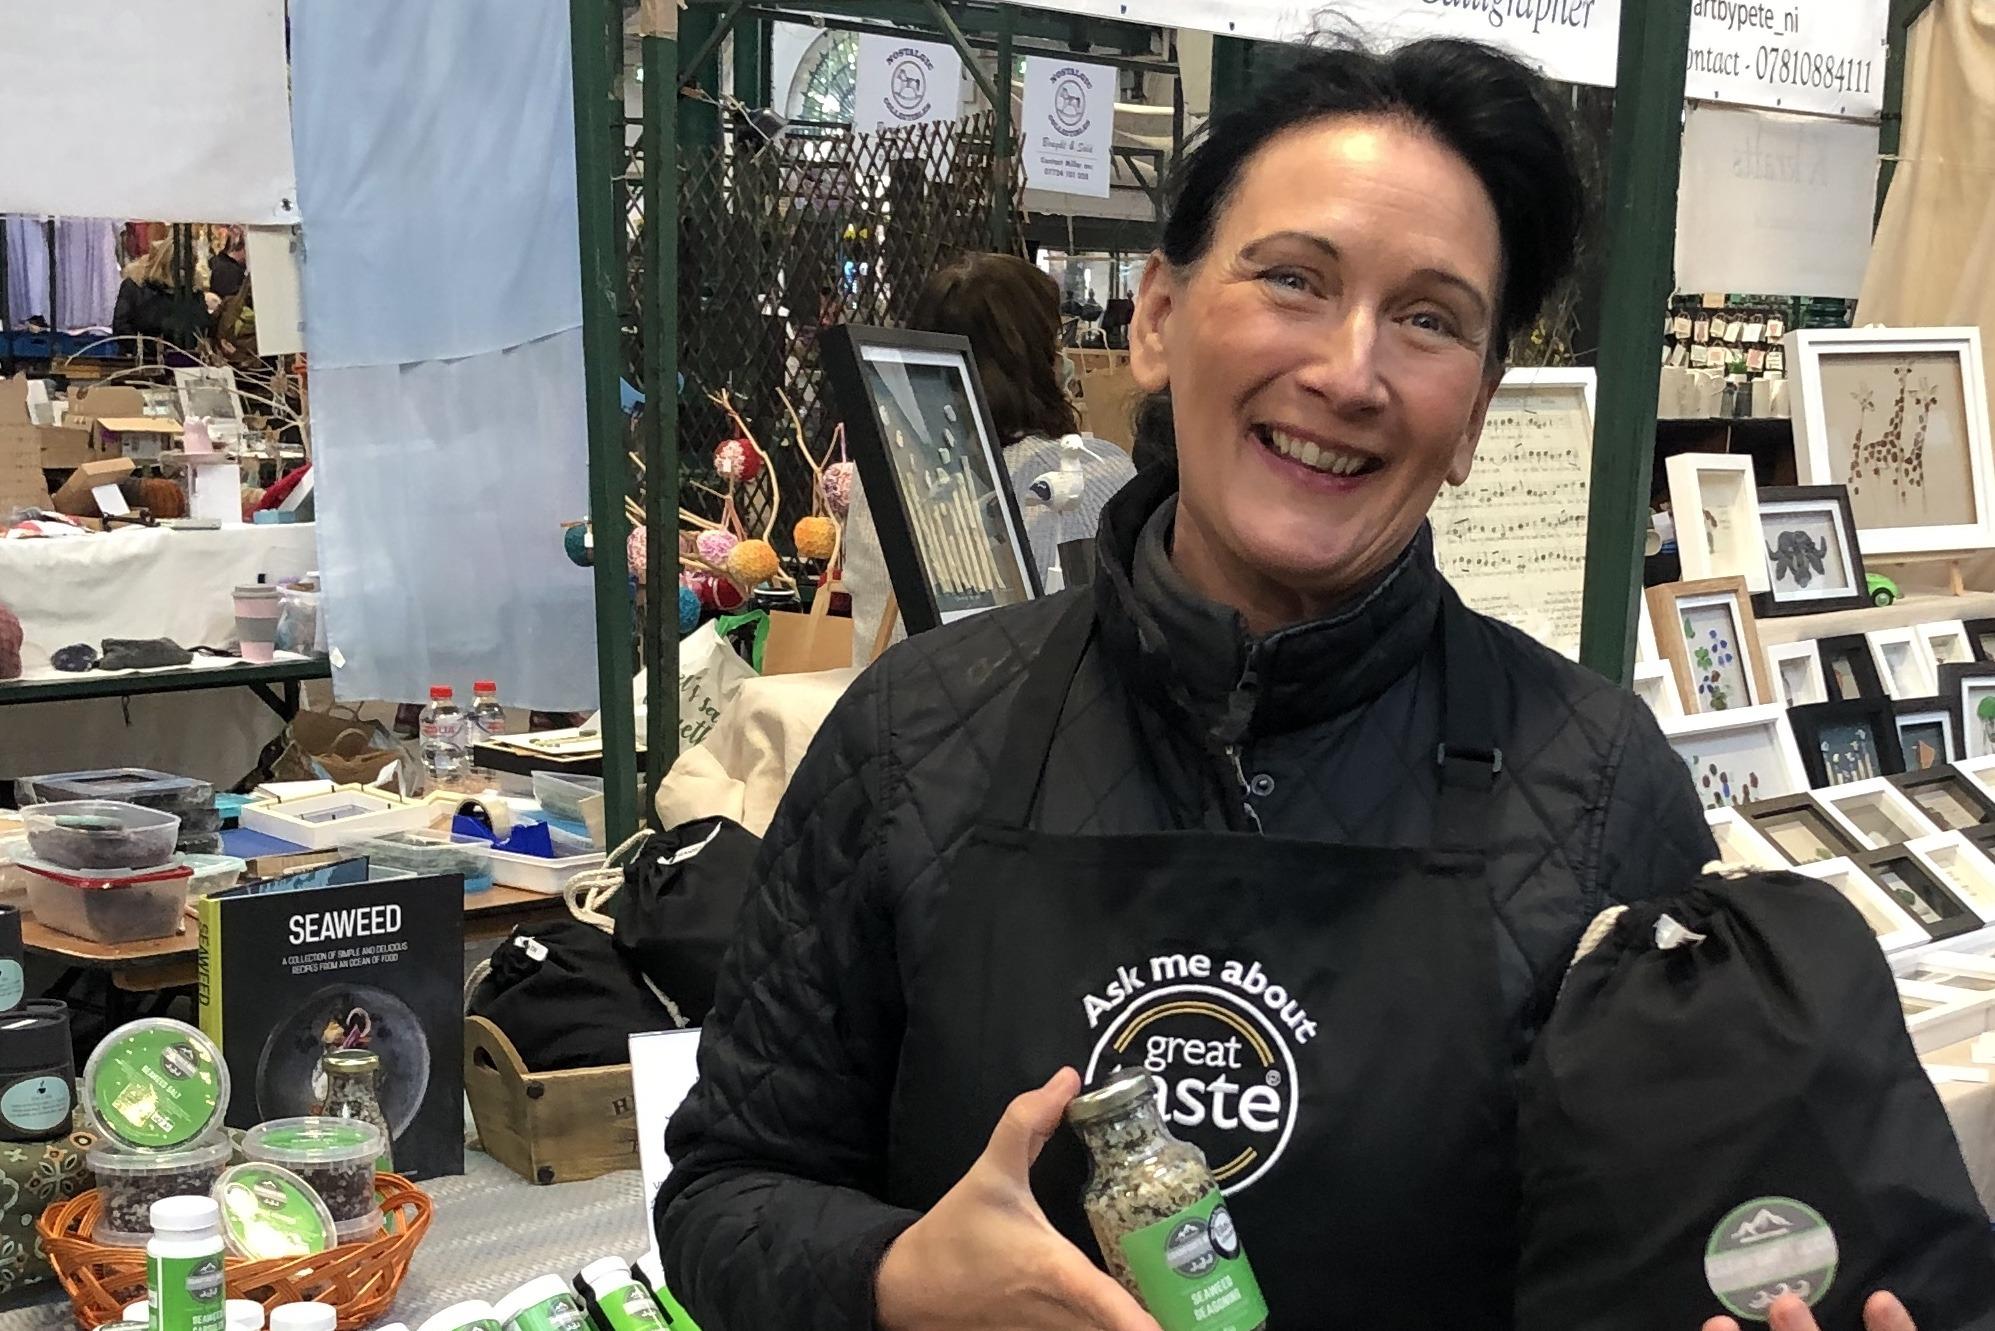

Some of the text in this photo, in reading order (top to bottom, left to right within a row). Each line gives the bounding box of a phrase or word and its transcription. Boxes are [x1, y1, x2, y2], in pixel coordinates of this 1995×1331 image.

[1422, 0, 1595, 34] grapher
[1686, 47, 1740, 77] ontact
[1755, 45, 1872, 94] 07810884111
[289, 904, 402, 945] SEAWEED
[199, 923, 210, 1007] SEAWEED
[288, 952, 327, 965] COLLECTION
[327, 950, 337, 960] OF
[338, 947, 361, 959] SIMPLE
[362, 945, 376, 955] AND
[376, 941, 409, 954] DELICIOUS
[292, 953, 399, 975] RECIPES FROM AN OCEAN OF FOOD
[1081, 953, 1319, 1045] Ask me about
[1144, 1035, 1243, 1073] great
[1111, 1065, 1281, 1132] aste
[1191, 1274, 1234, 1306] SEAWEED
